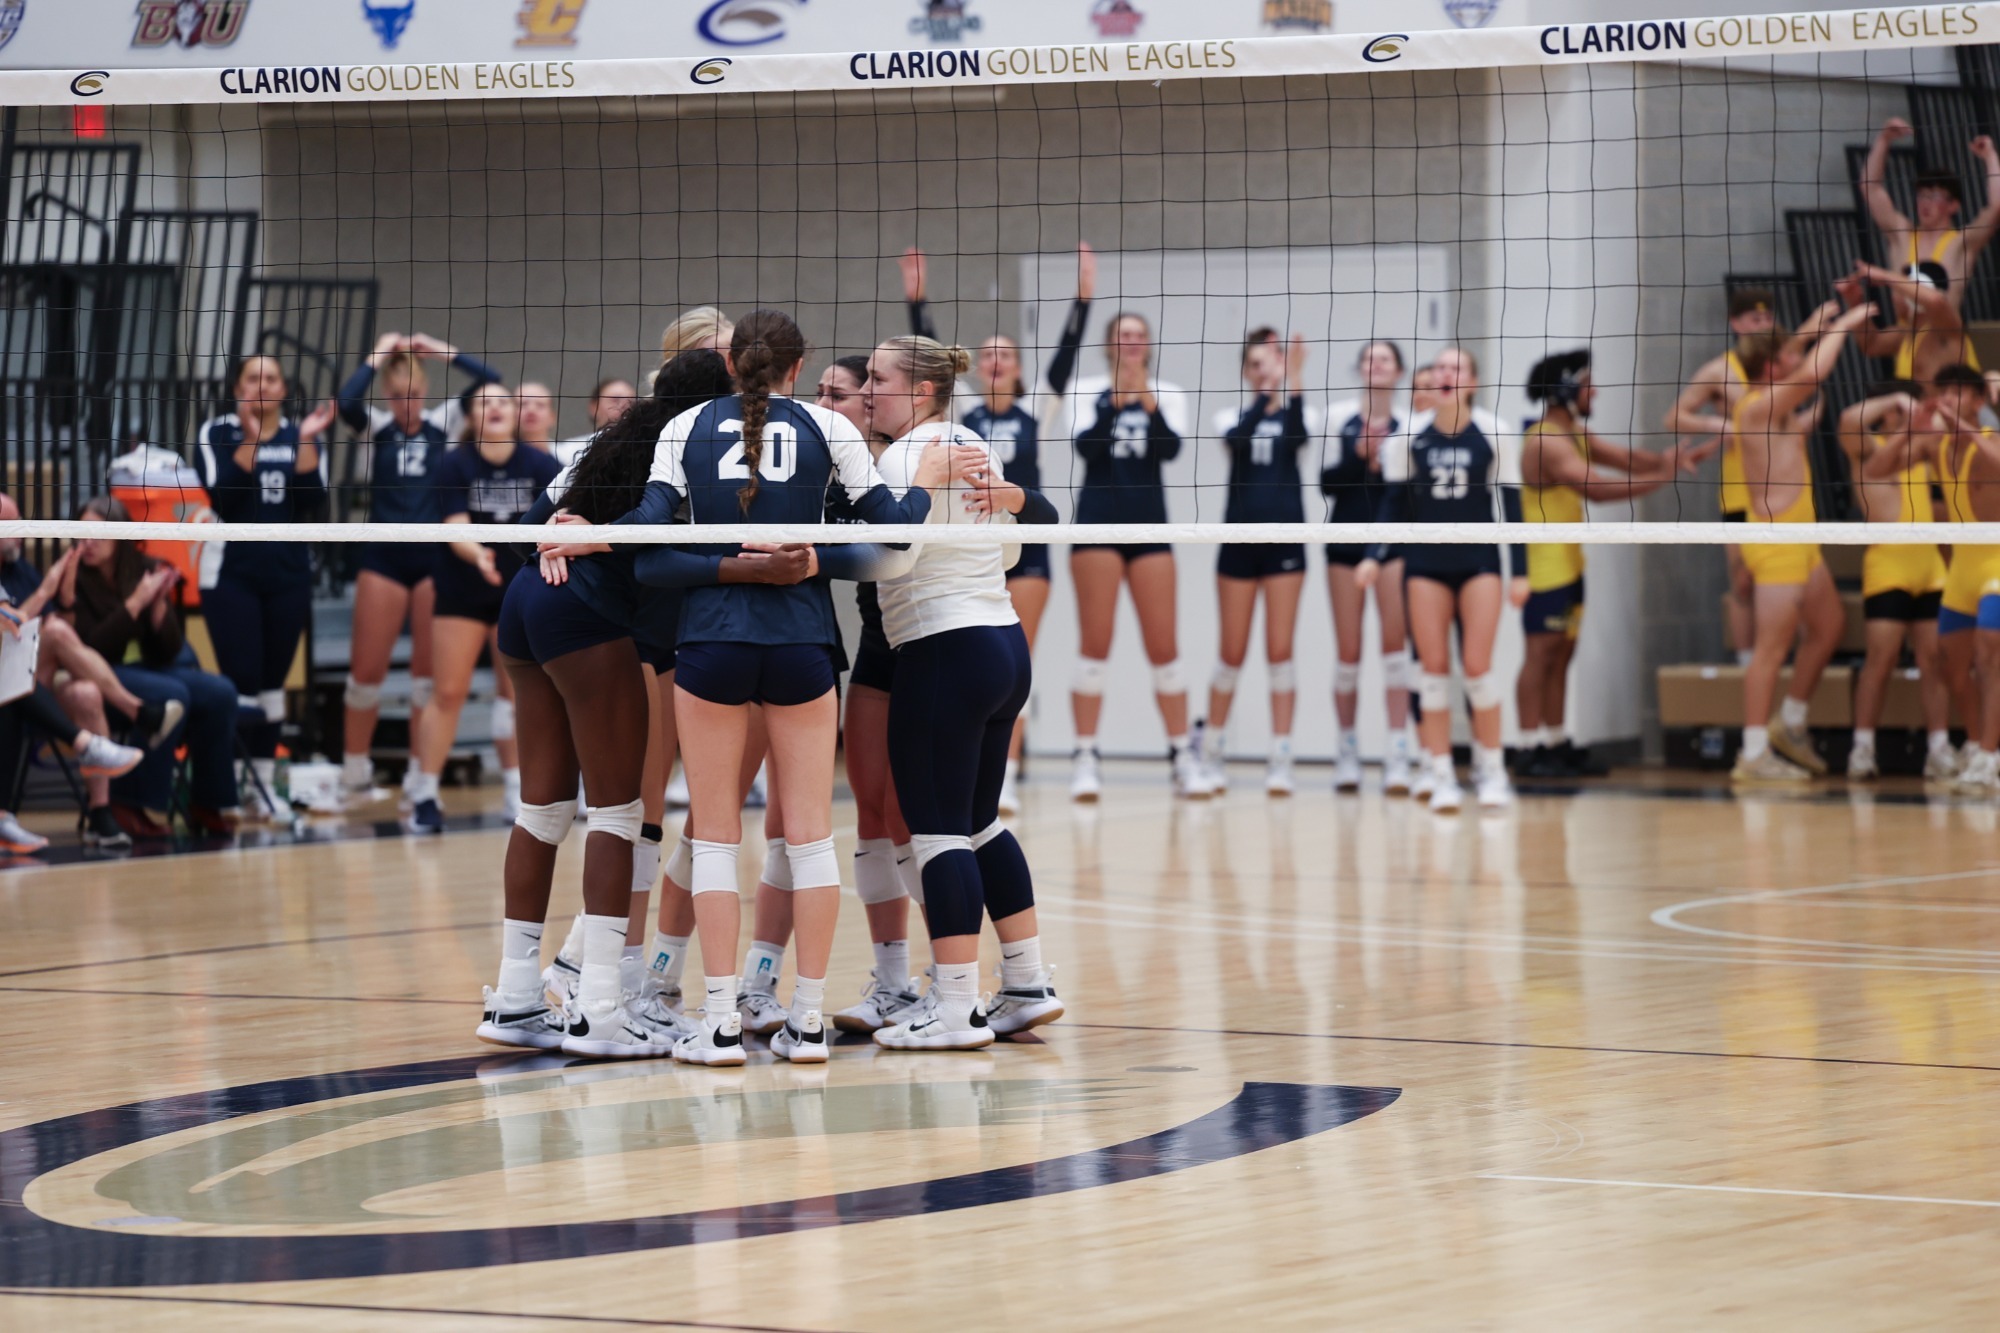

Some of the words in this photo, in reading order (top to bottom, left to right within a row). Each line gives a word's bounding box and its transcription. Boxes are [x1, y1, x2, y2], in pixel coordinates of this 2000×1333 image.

[1539, 20, 1687, 55] CLARION
[1694, 14, 1832, 48] GOLDEN
[1852, 5, 1979, 40] EAGLES
[220, 66, 341, 94] CLARION
[346, 64, 460, 91] GOLDEN
[475, 61, 575, 90] EAGLES
[850, 49, 981, 80] CLARION
[986, 45, 1109, 75] GOLDEN
[1126, 41, 1236, 71] EAGLES
[718, 418, 797, 483] 20
